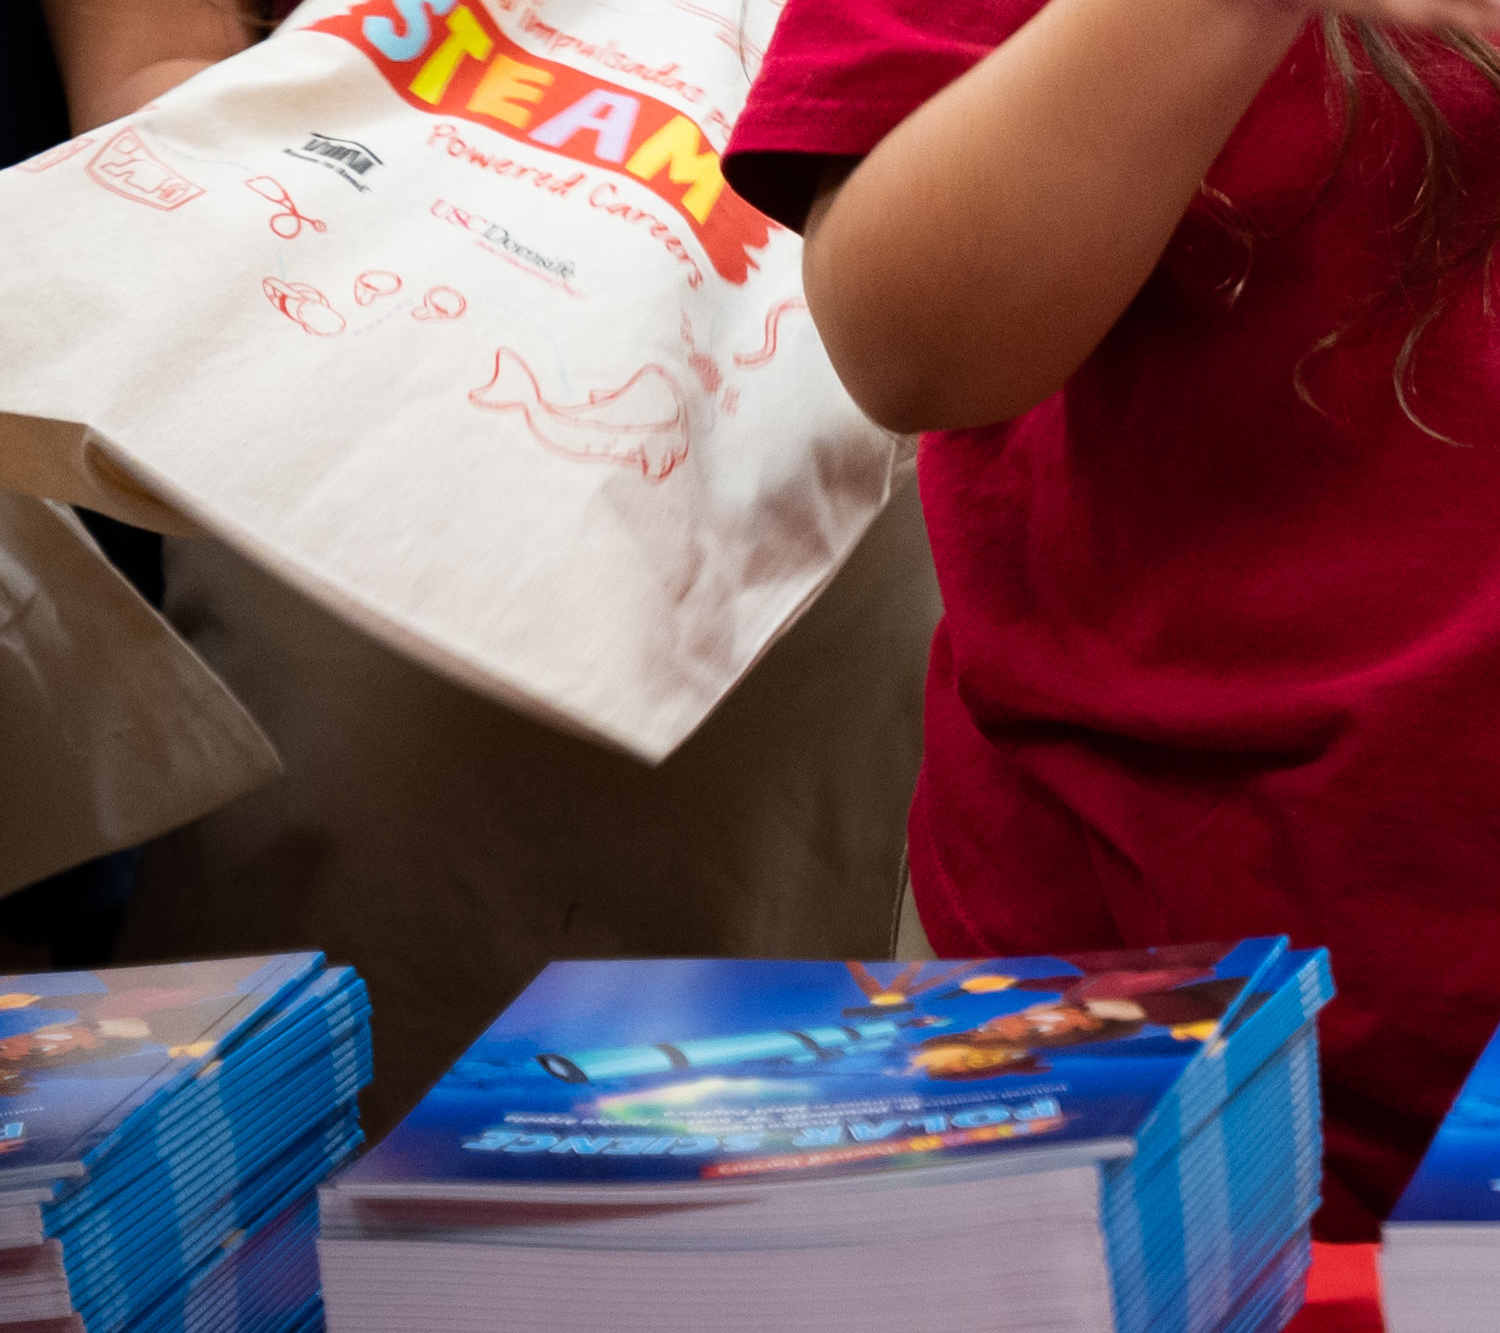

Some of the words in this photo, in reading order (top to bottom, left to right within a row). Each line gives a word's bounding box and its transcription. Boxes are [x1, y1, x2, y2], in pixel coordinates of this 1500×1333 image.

[426, 123, 586, 197] Powered
[588, 181, 703, 291] Careers
[461, 1129, 766, 1155] SCIENCE
[789, 1095, 1061, 1148] POLAR
